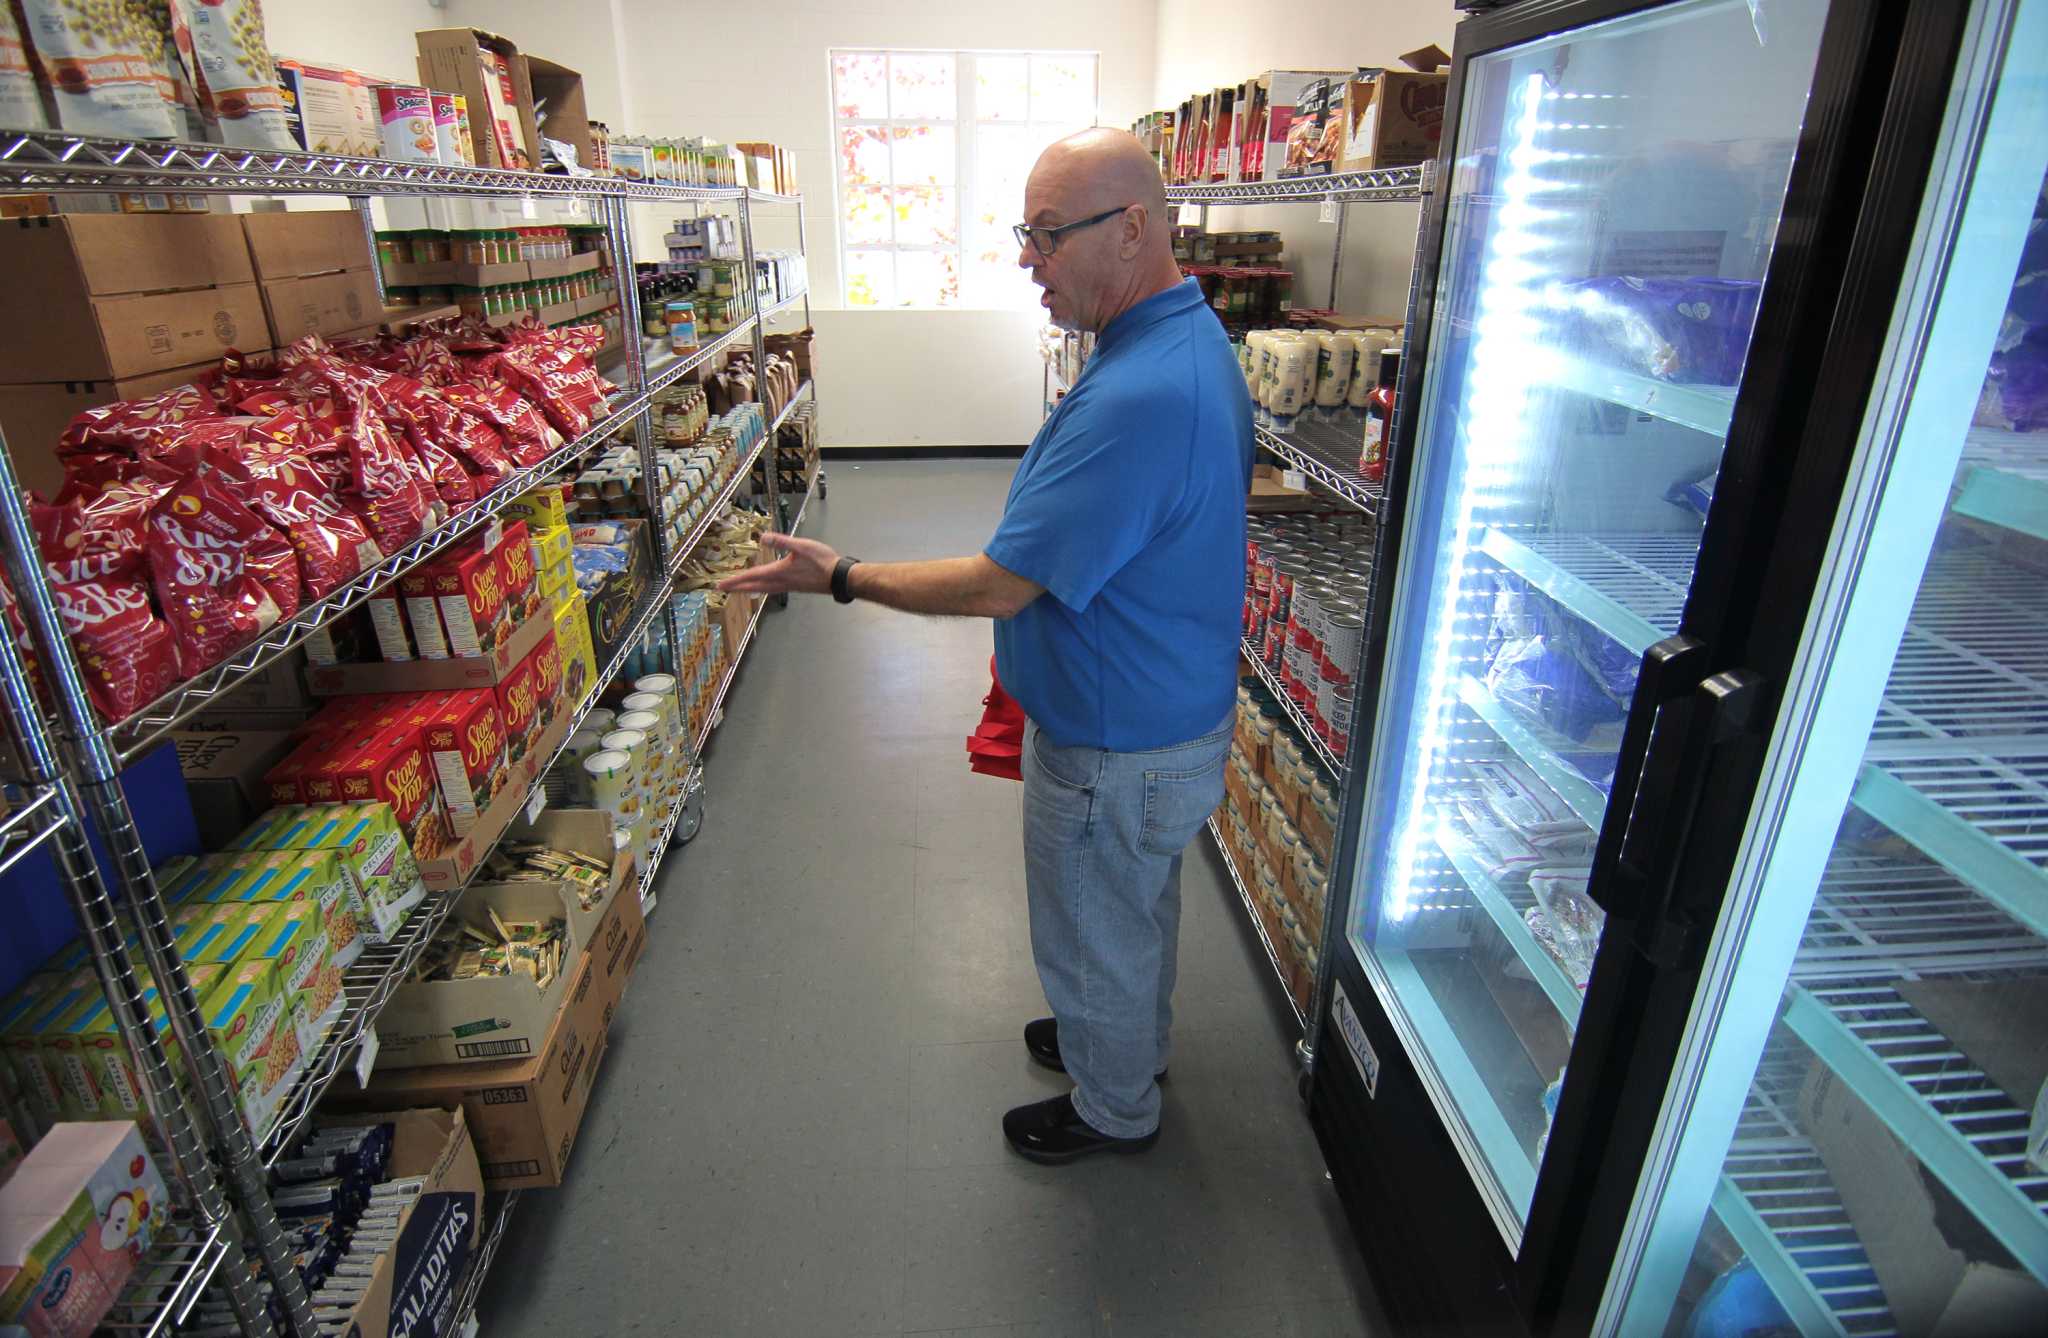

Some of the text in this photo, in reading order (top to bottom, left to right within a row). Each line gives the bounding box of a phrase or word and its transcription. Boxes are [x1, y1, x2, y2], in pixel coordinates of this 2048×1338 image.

[504, 537, 527, 585] Stove
[517, 560, 529, 588] Top
[472, 561, 497, 614] Stove
[486, 584, 499, 615] Top
[507, 671, 531, 726] Stove
[520, 694, 532, 725] Top
[187, 735, 241, 771] Chex
[468, 707, 496, 768] Stove
[482, 730, 497, 767] Top
[385, 749, 422, 816] Stove
[402, 775, 423, 814] Top
[378, 831, 399, 856] SALAD
[484, 1088, 526, 1106] 05363
[391, 1202, 469, 1338] SALADITAS
